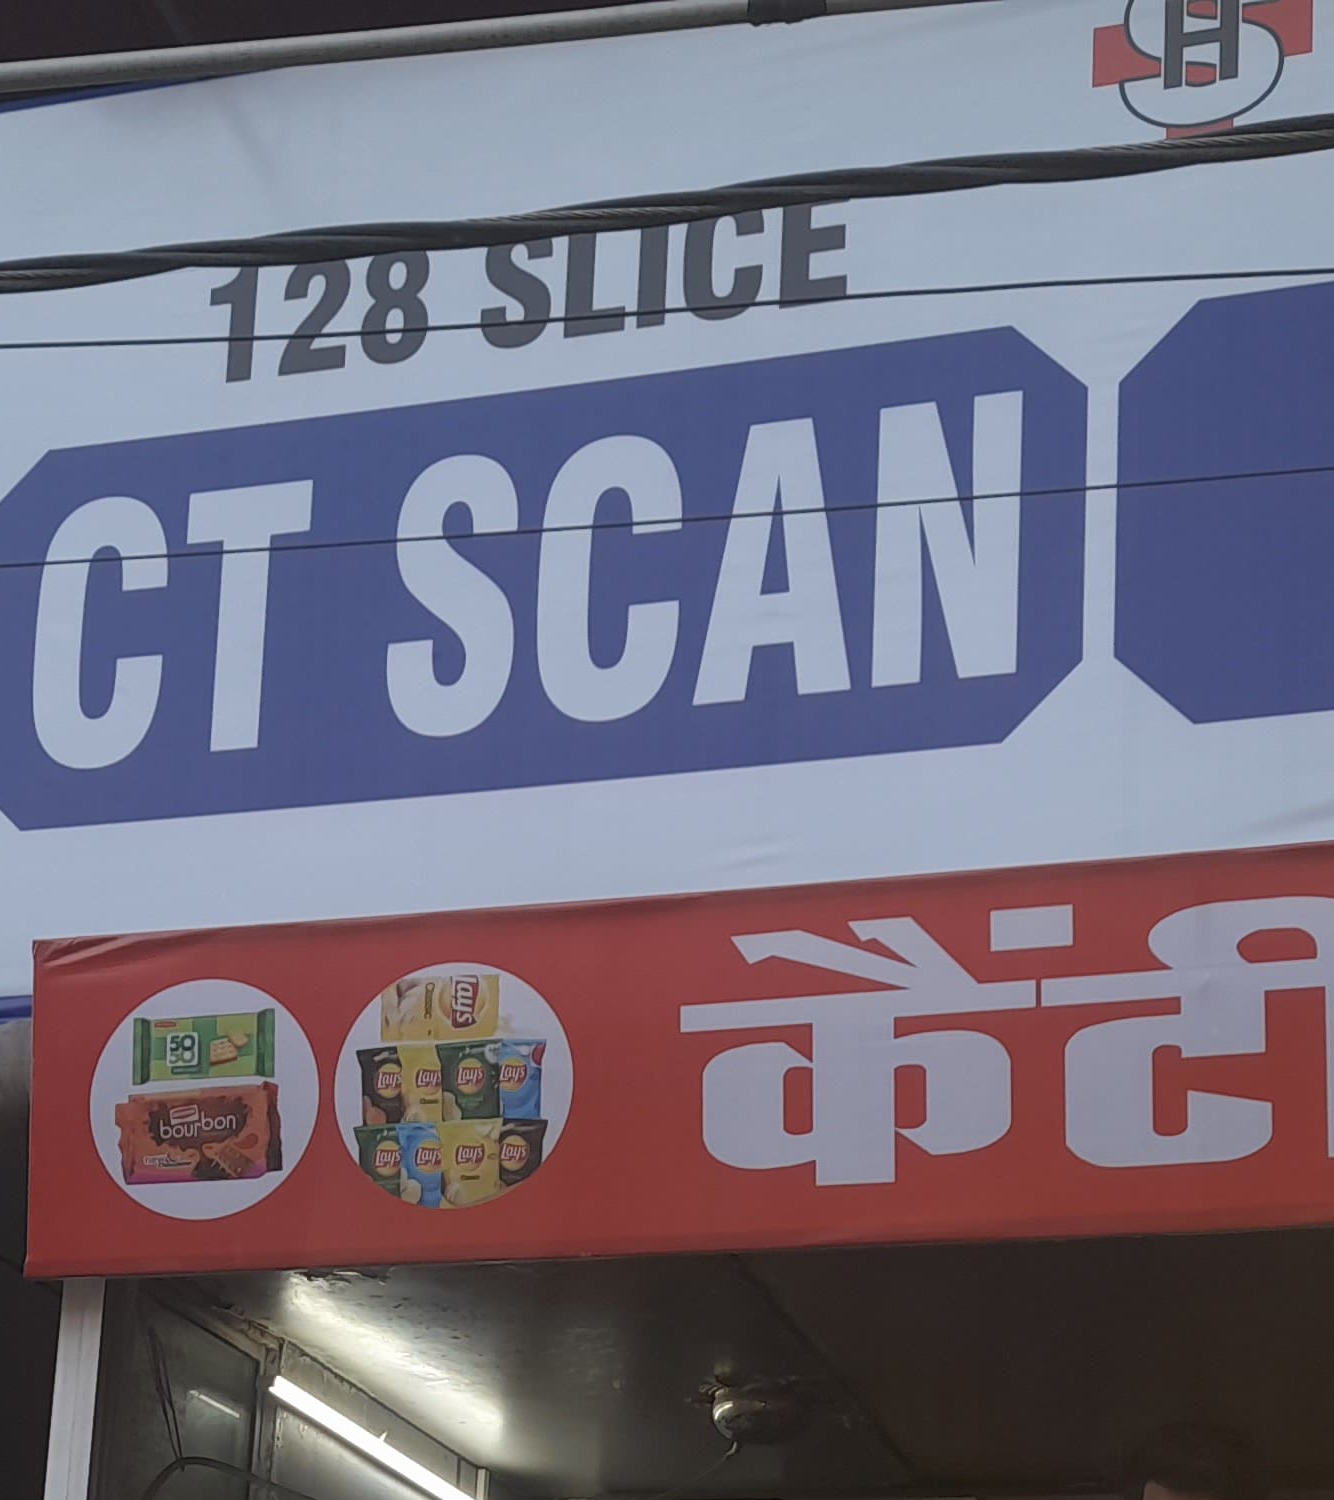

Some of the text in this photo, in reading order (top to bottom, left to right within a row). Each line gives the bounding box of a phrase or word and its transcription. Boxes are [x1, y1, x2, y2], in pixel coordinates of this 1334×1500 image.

[209, 197, 852, 385] 128 SLICE
[31, 389, 1025, 770] CT SCAN
[169, 1034, 196, 1051] 50
[159, 1112, 236, 1139] bourbon
